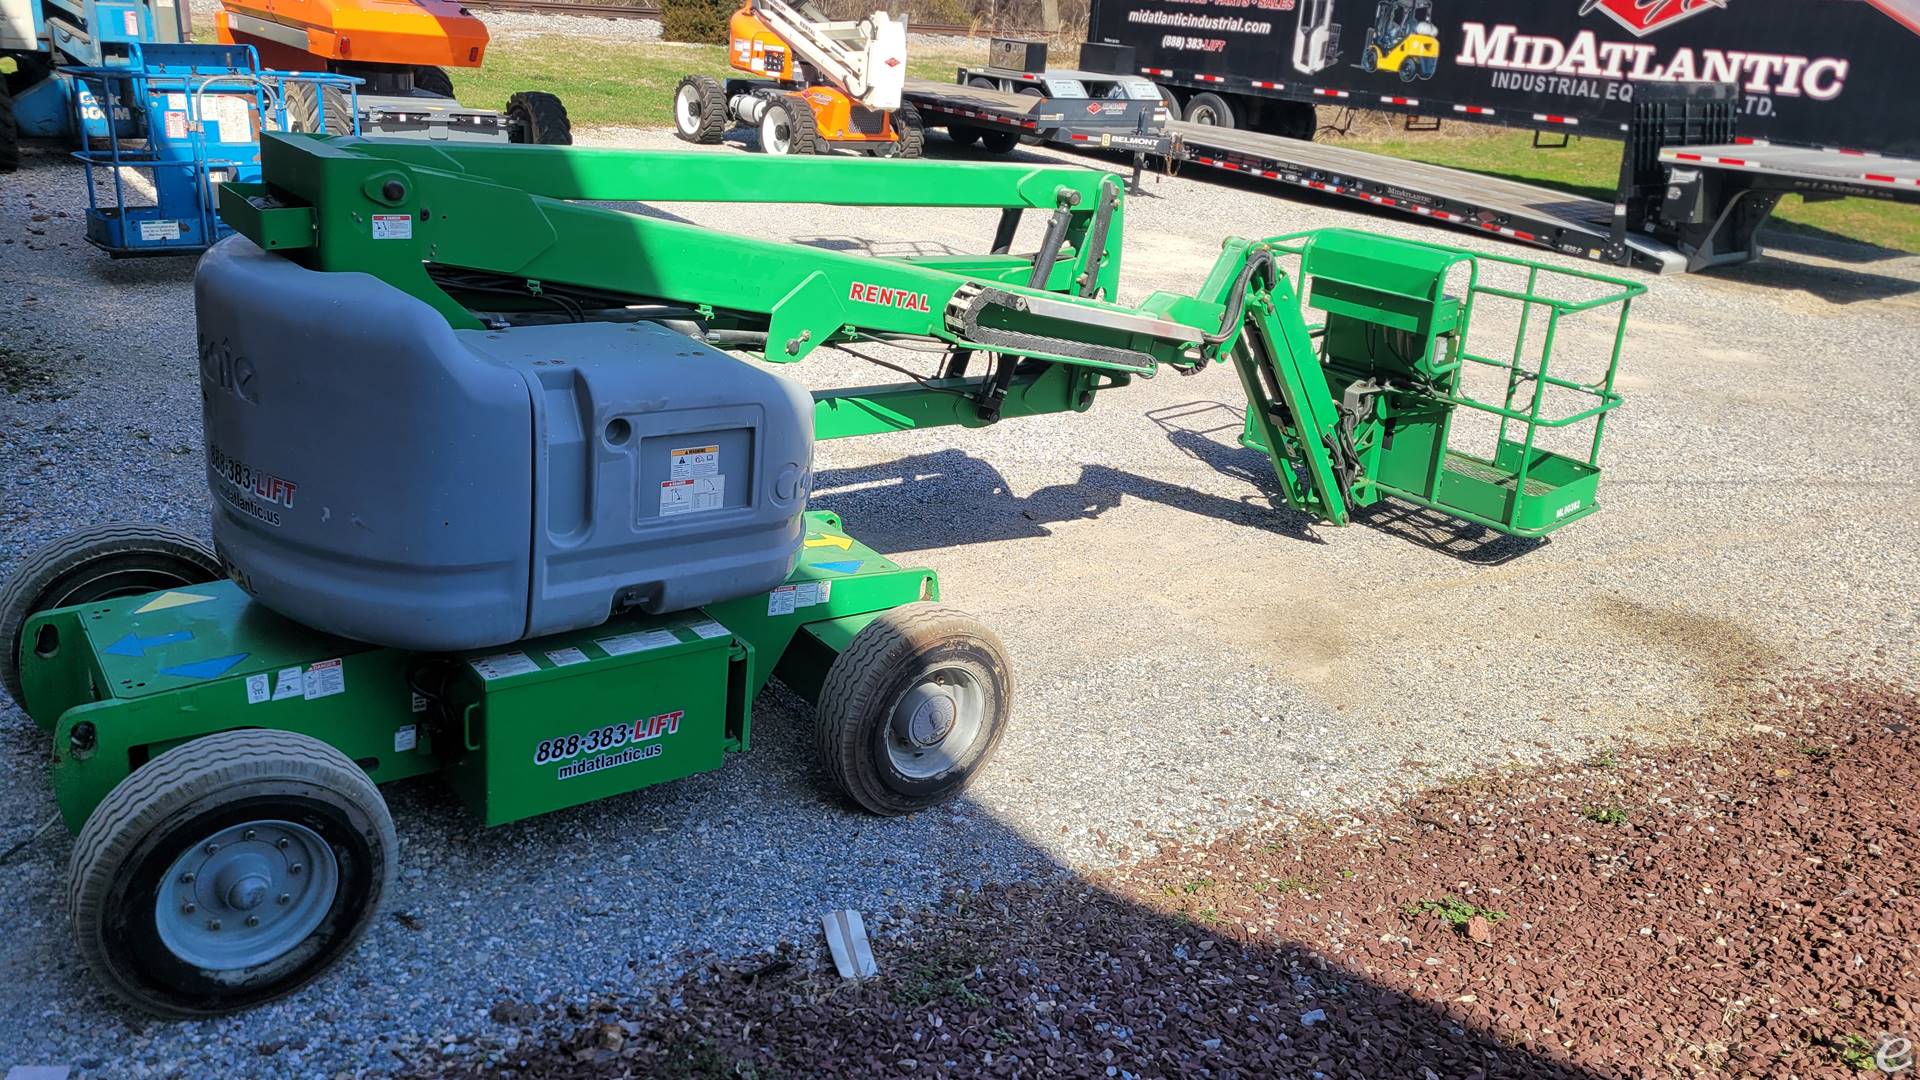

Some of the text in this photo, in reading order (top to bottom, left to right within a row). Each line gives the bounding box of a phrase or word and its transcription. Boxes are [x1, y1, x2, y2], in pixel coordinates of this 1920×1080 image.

[1128, 10, 1271, 34] midatlanticindustrial.com
[1162, 35, 1226, 52] (888) 383-LIFT
[1491, 71, 1602, 99] INDUSTRIAL
[1736, 95, 1777, 117] TD.
[1112, 135, 1159, 146] BELMONT
[849, 281, 931, 313] RENTAL
[558, 743, 662, 780] midatlantic.us
